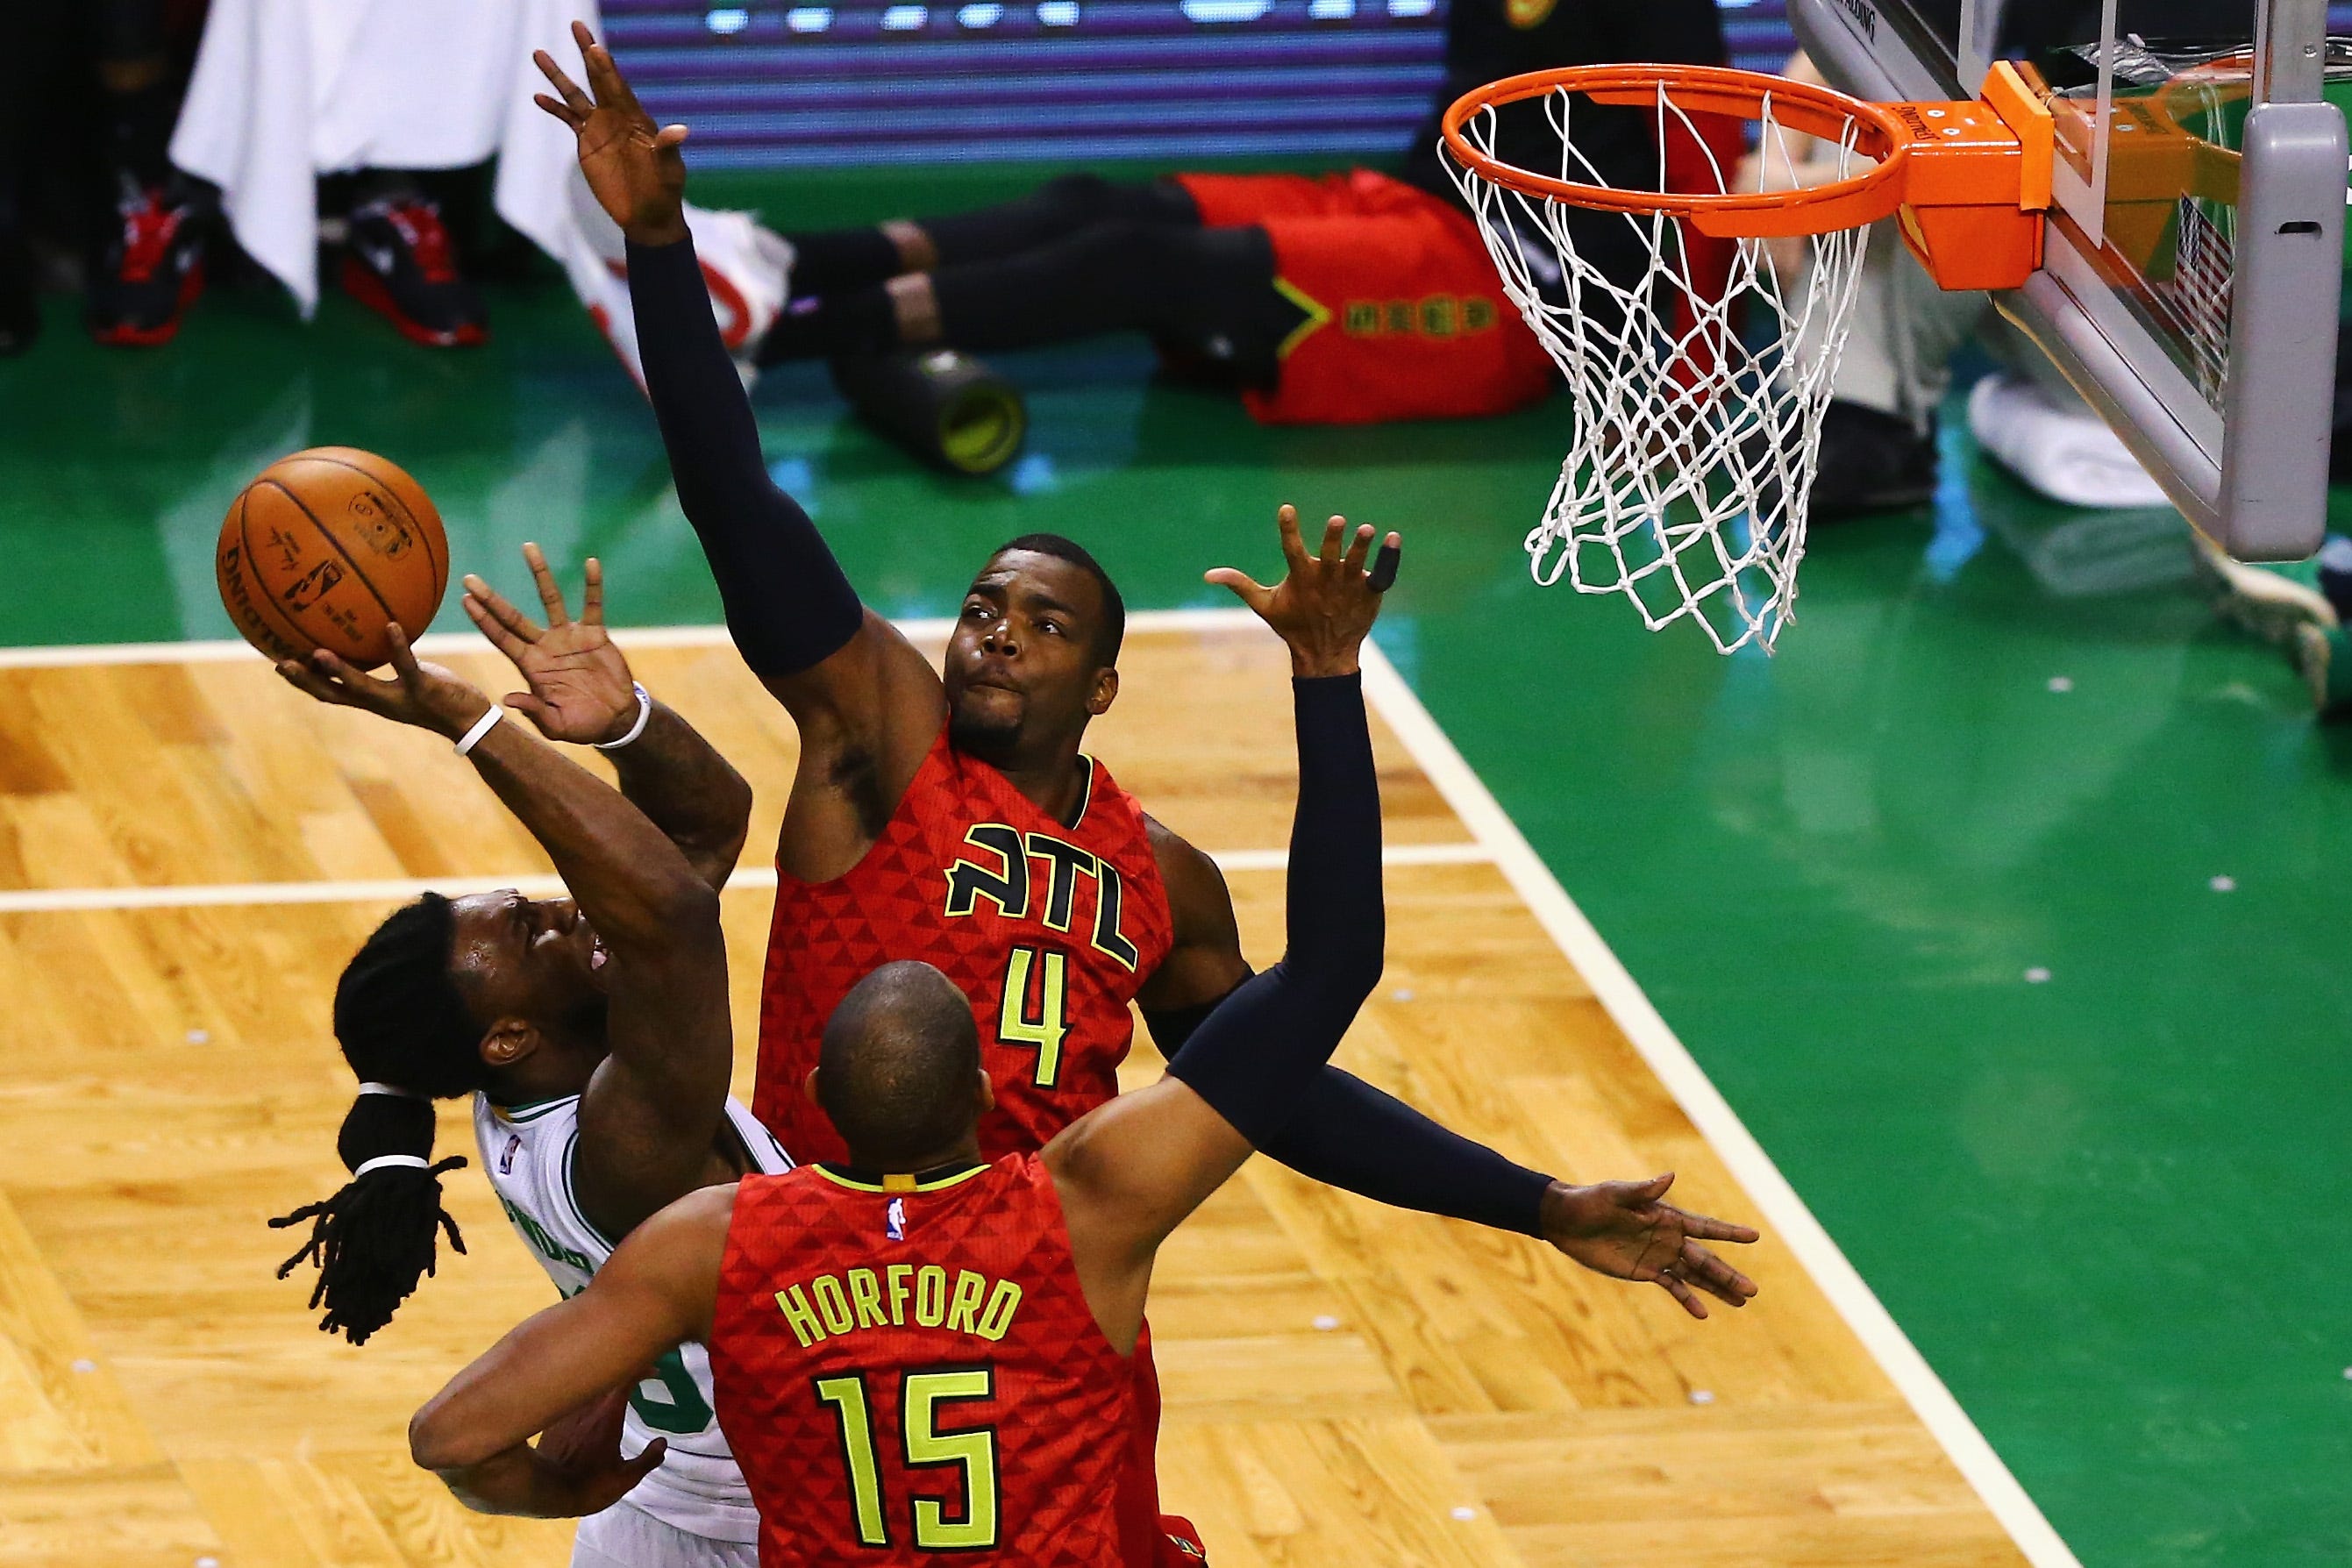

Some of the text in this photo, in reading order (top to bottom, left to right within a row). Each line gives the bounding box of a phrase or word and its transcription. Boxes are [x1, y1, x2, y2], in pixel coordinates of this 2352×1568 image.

[1840, 0, 1876, 46] ALDING
[944, 823, 1138, 973] ATL
[998, 946, 1072, 1088] 4
[774, 1264, 1023, 1348] HORFORD
[814, 1368, 996, 1550] 15
